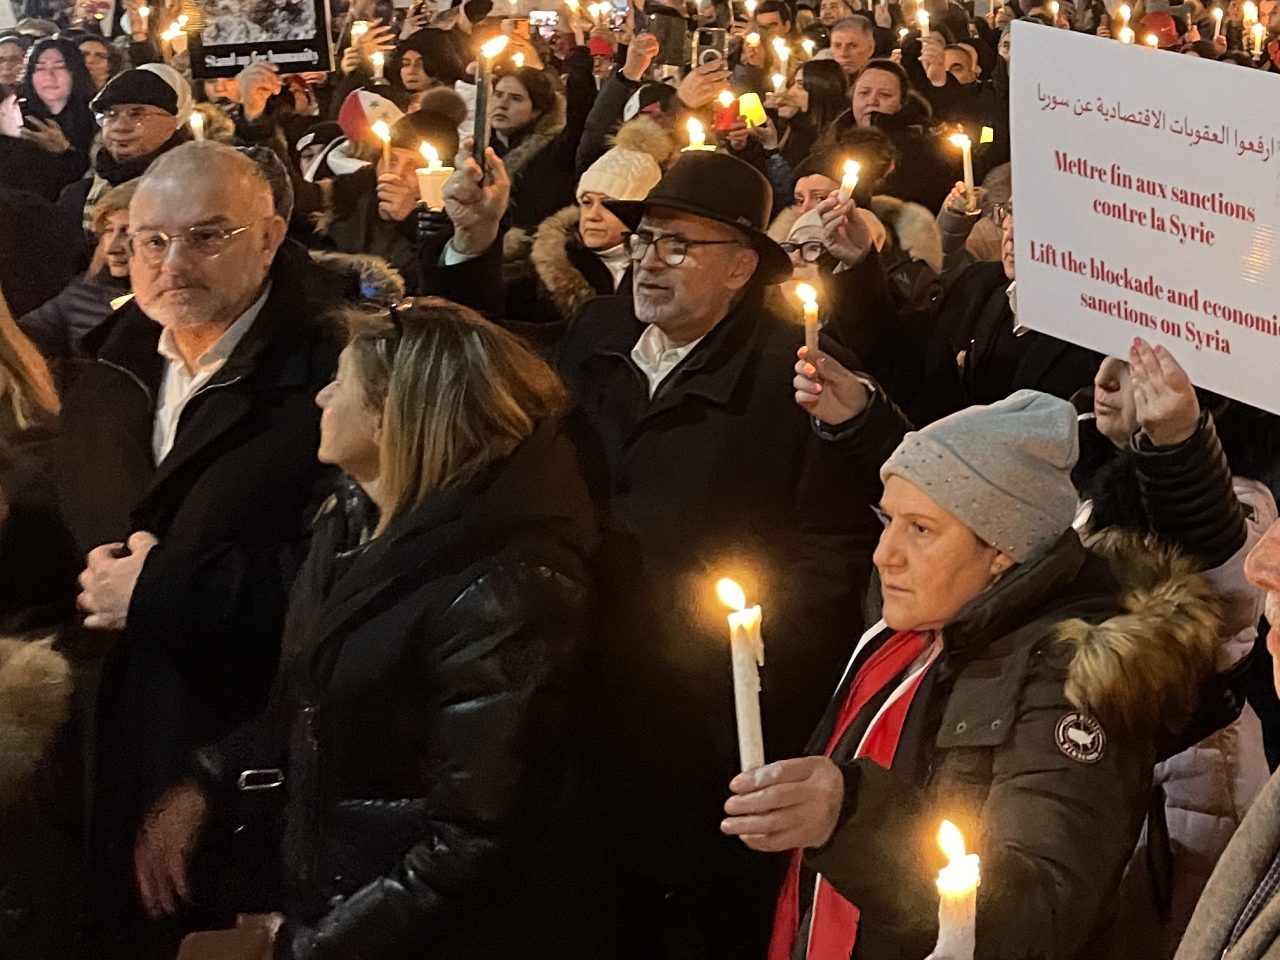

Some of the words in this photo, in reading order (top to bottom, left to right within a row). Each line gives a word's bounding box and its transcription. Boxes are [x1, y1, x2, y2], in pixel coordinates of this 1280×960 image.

[1037, 83, 1070, 111] سوريا
[1073, 100, 1093, 116] عن
[1097, 97, 1166, 130] الاقتصادية
[1170, 116, 1229, 147] العقوبات
[1235, 129, 1275, 161] ارفعوا
[1054, 150, 1108, 183] Mettre
[1110, 163, 1133, 190] fin
[1136, 177, 1167, 199] aux
[1171, 186, 1256, 223] sanctions
[1093, 197, 1147, 227] contre
[1150, 208, 1166, 233] la
[1170, 214, 1215, 246] Syrie
[1030, 240, 1058, 267] Lift
[1061, 251, 1087, 275] the
[1090, 257, 1164, 300] blockade
[1167, 289, 1199, 312] and
[1080, 292, 1158, 330] sanctions
[1160, 318, 1181, 338] on
[1185, 320, 1232, 355] Syria
